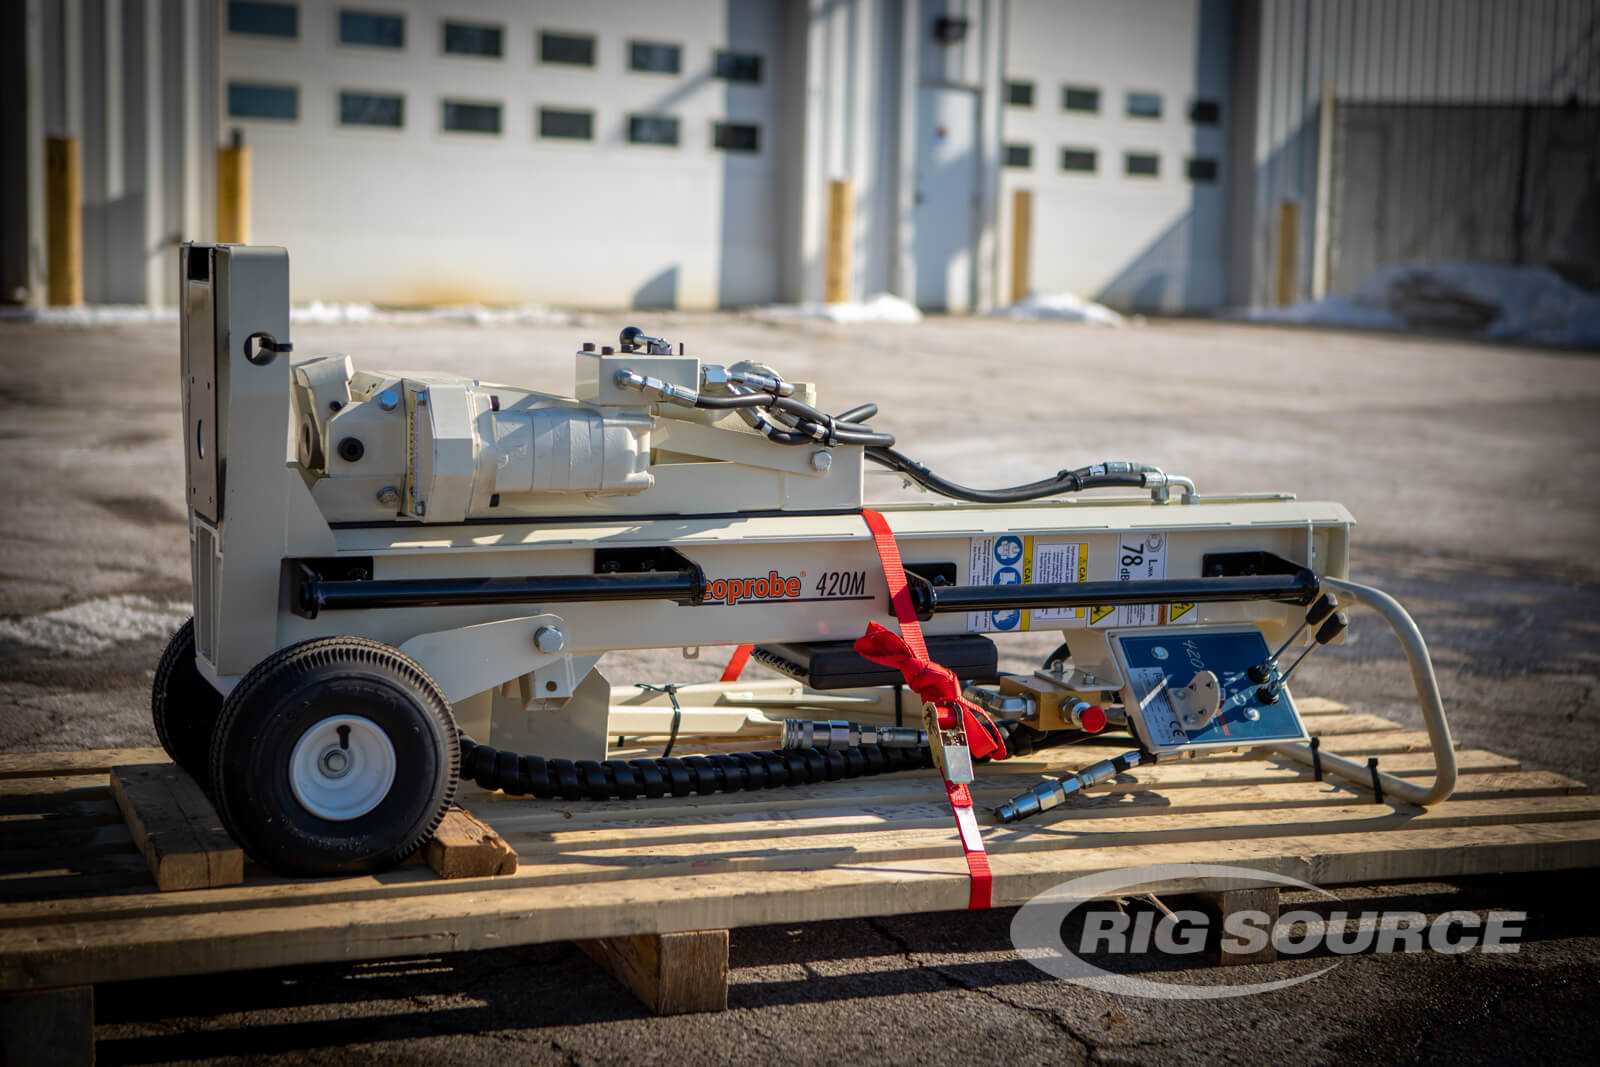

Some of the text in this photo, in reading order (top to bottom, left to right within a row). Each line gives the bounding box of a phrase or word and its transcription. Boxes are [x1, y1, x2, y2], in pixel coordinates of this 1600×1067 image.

[1121, 543, 1144, 567] 78
[703, 571, 866, 605] eoprobe 420M
[1182, 639, 1205, 669] 420
